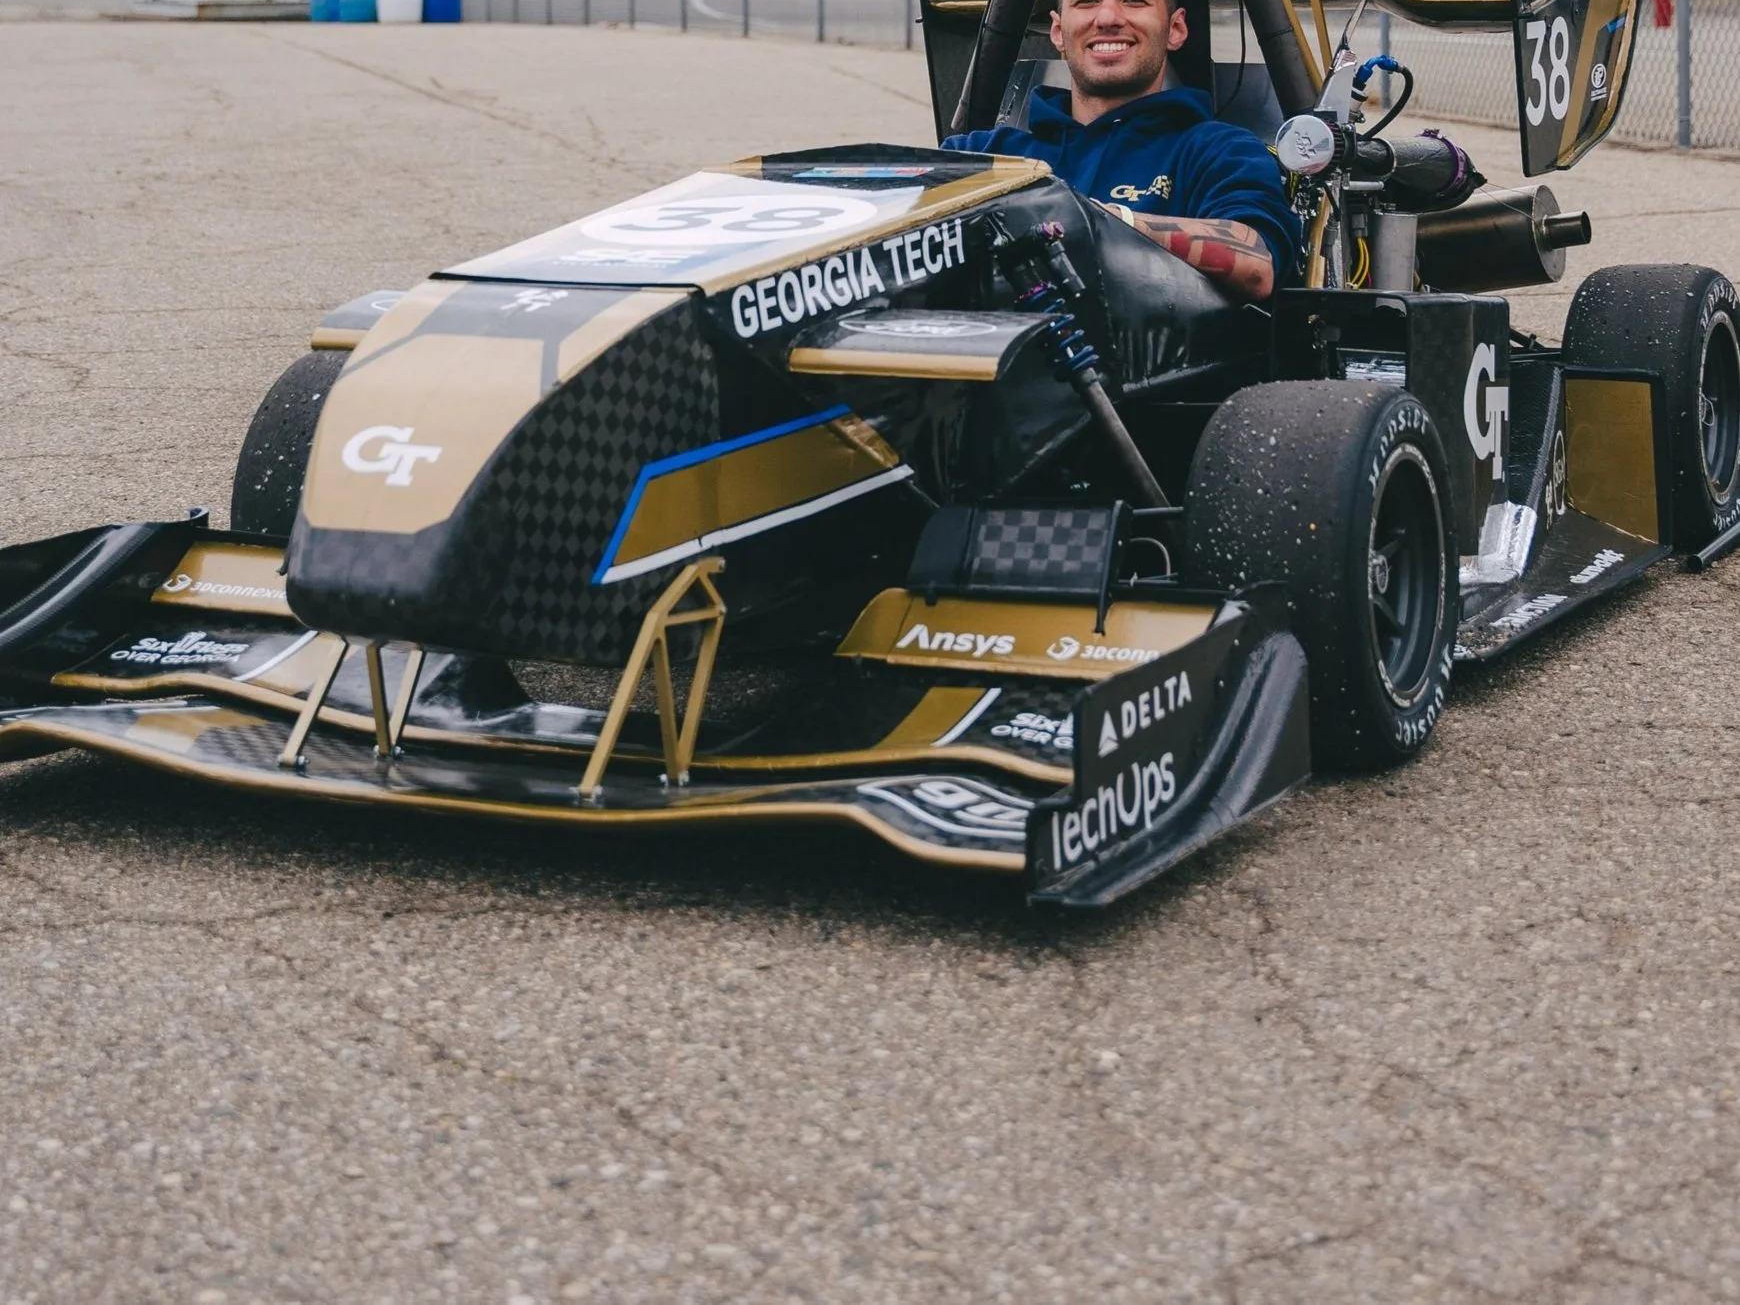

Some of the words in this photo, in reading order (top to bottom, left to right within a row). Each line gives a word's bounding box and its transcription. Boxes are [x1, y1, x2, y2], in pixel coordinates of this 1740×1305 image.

[1525, 16, 1570, 126] 38
[610, 206, 845, 233] 38
[732, 241, 887, 338] GEORGIA
[883, 219, 965, 273] TECH
[1464, 342, 1509, 483] GT
[341, 425, 443, 487] GT
[896, 623, 1016, 657] Ansys
[991, 725, 1052, 744] OVER
[1121, 670, 1192, 739] DELTA
